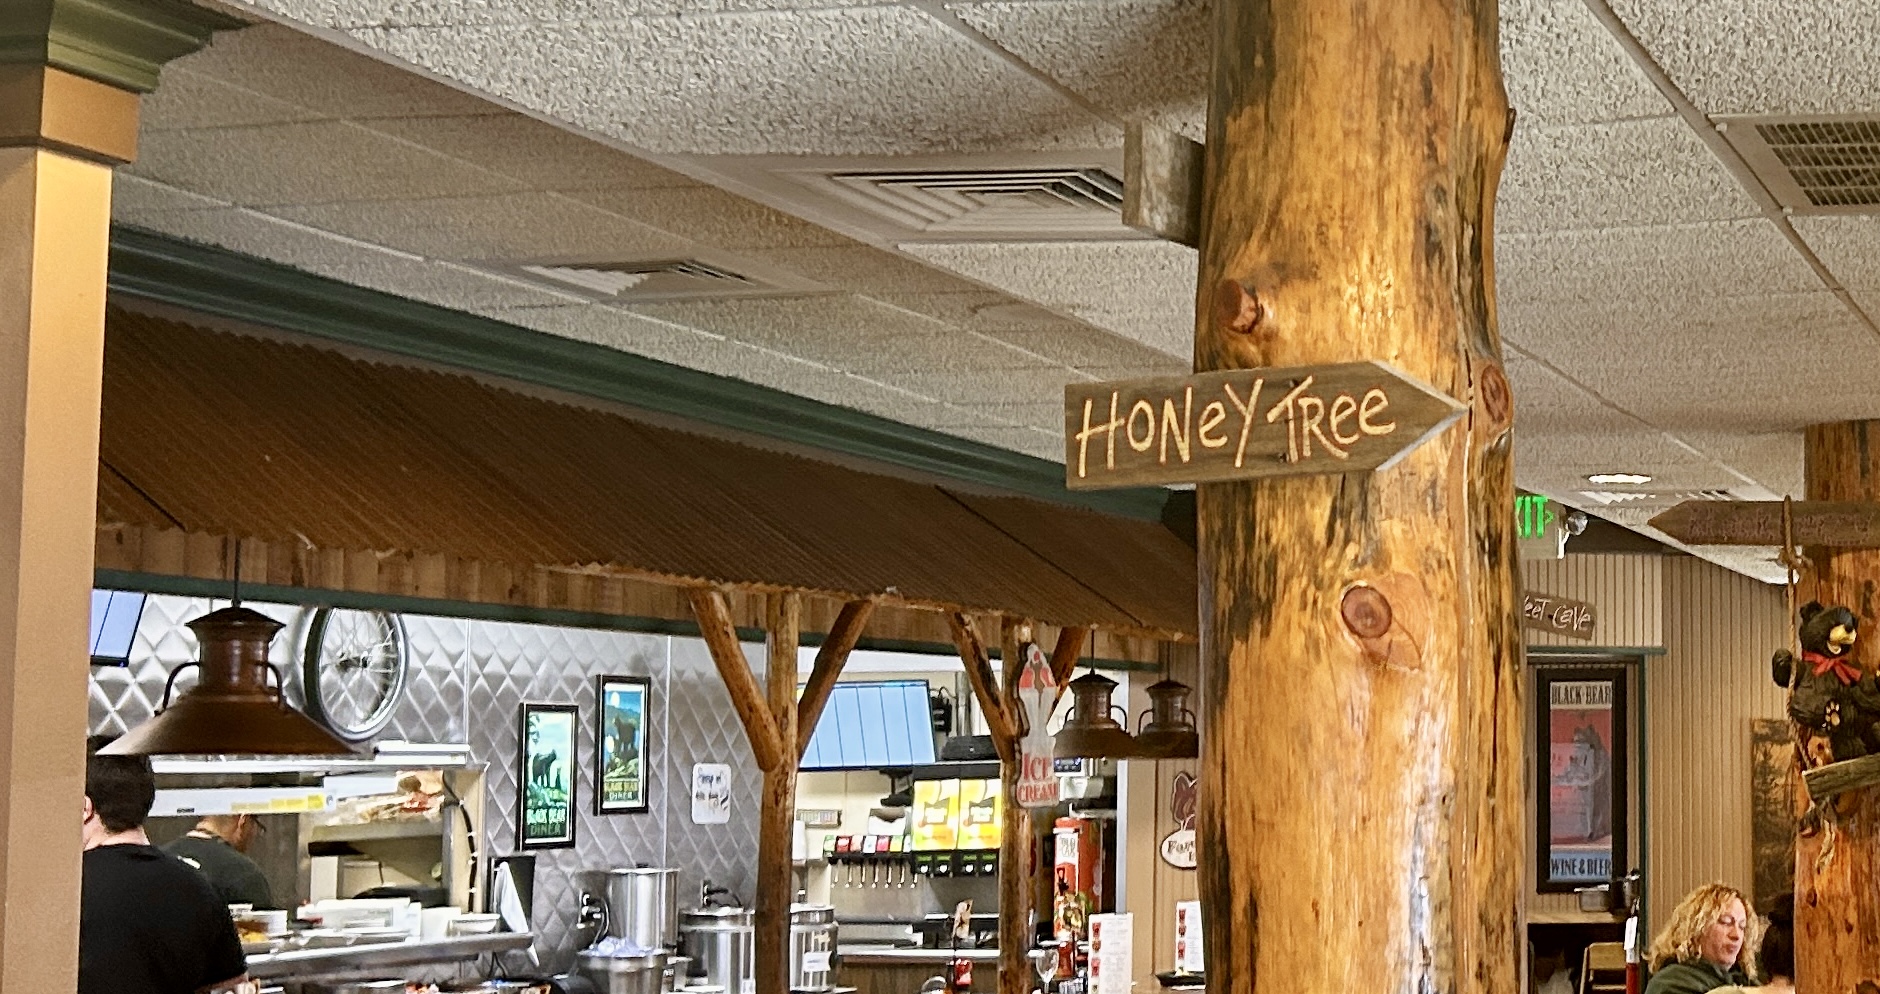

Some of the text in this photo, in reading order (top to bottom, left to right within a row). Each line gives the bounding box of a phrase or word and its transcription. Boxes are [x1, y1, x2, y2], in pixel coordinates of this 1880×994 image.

[1551, 685, 1612, 705] BLACK BEAR
[1551, 858, 1577, 877] WINE
[1587, 857, 1612, 877] BEER
